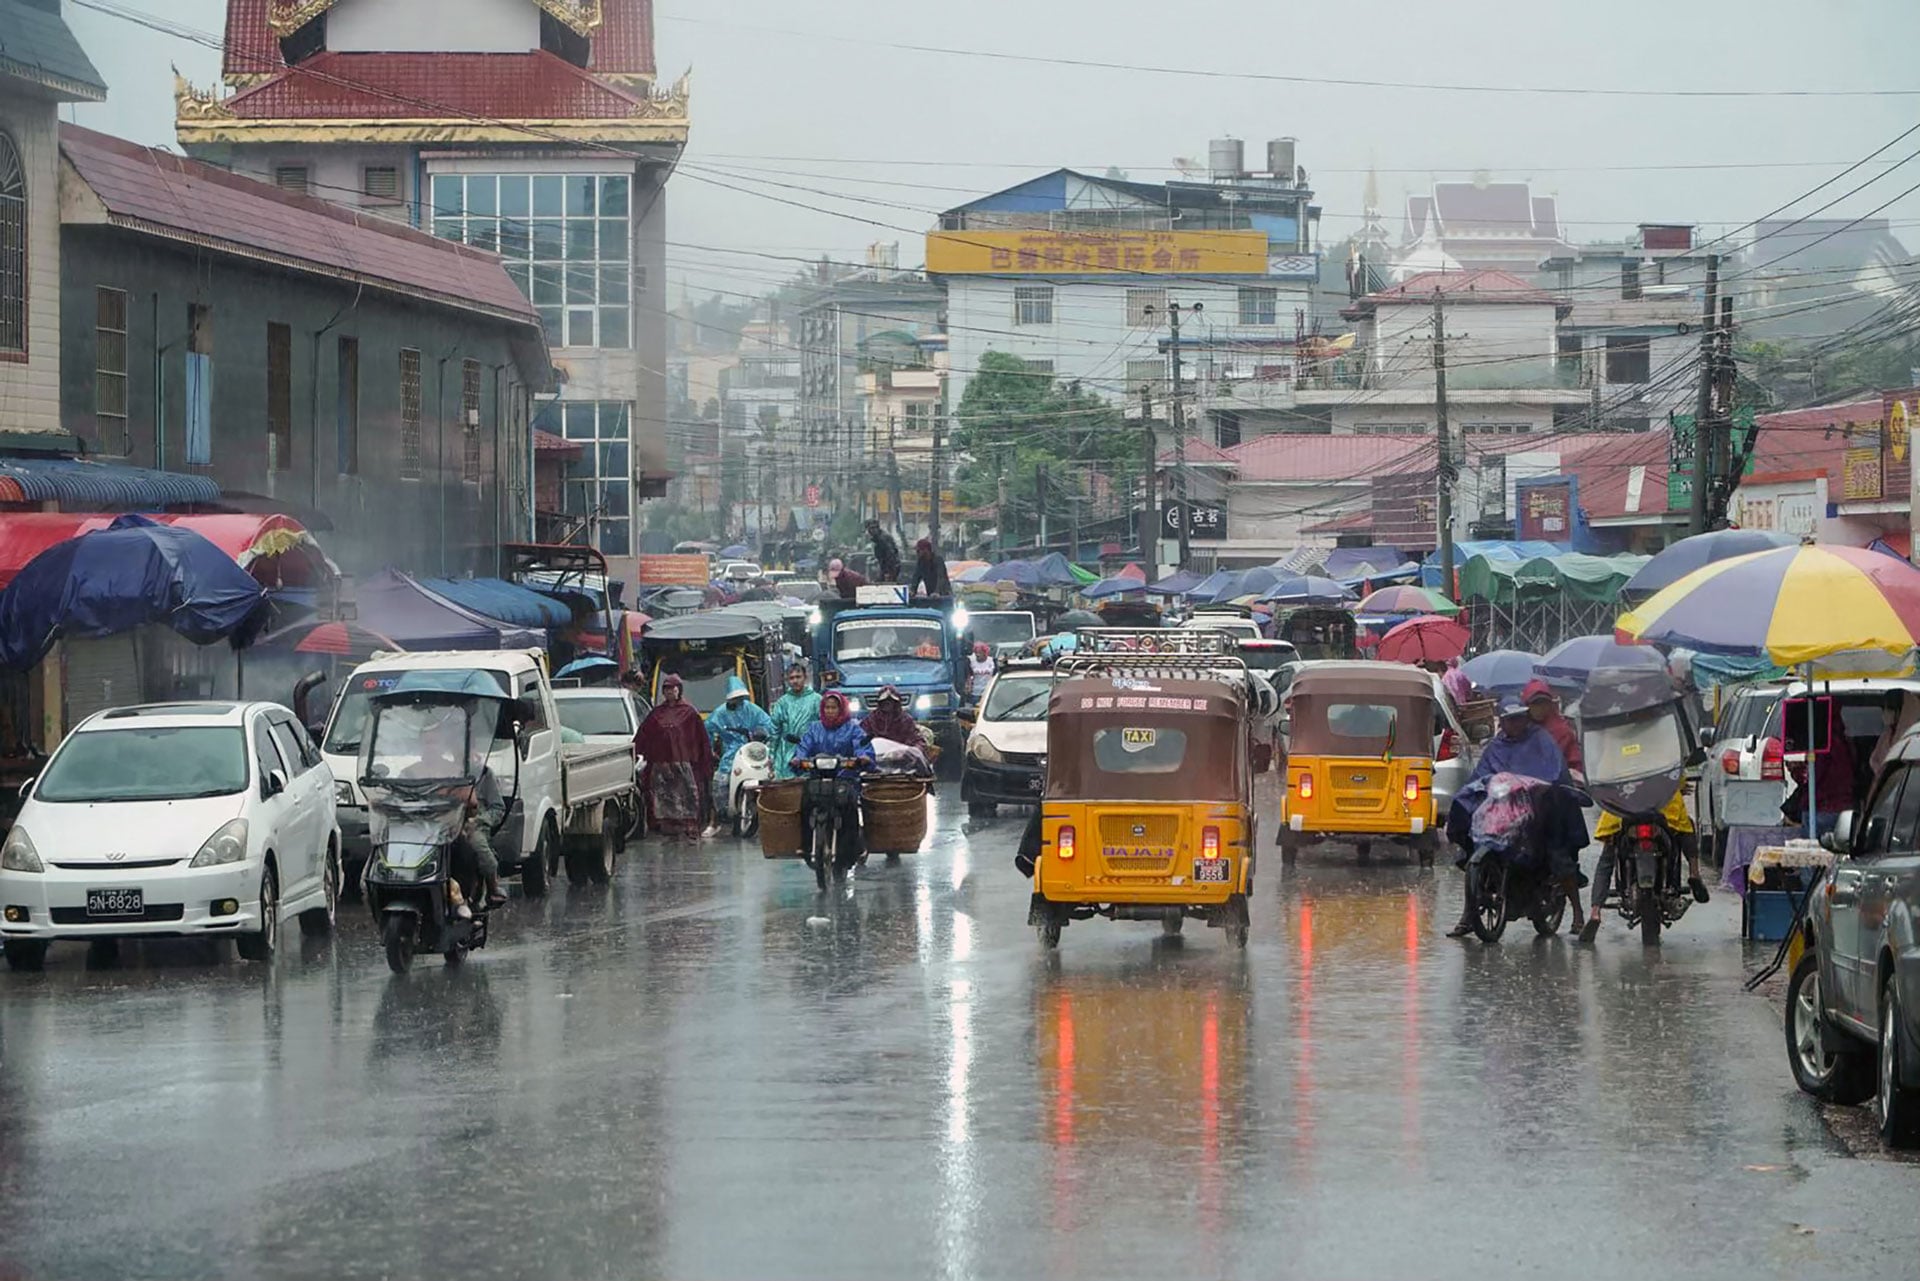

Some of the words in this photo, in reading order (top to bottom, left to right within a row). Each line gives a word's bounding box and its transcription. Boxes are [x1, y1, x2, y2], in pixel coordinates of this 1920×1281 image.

[1081, 697, 1093, 709] DO
[1096, 697, 1113, 708] NOT
[1117, 696, 1147, 708] FORGET
[1148, 697, 1191, 709] REMEMBER
[1193, 699, 1208, 710] ME
[1125, 730, 1152, 742] TAXI
[1102, 847, 1162, 857] BAJAJ
[1199, 870, 1224, 881] 9556
[89, 894, 141, 910] 5N-6828
